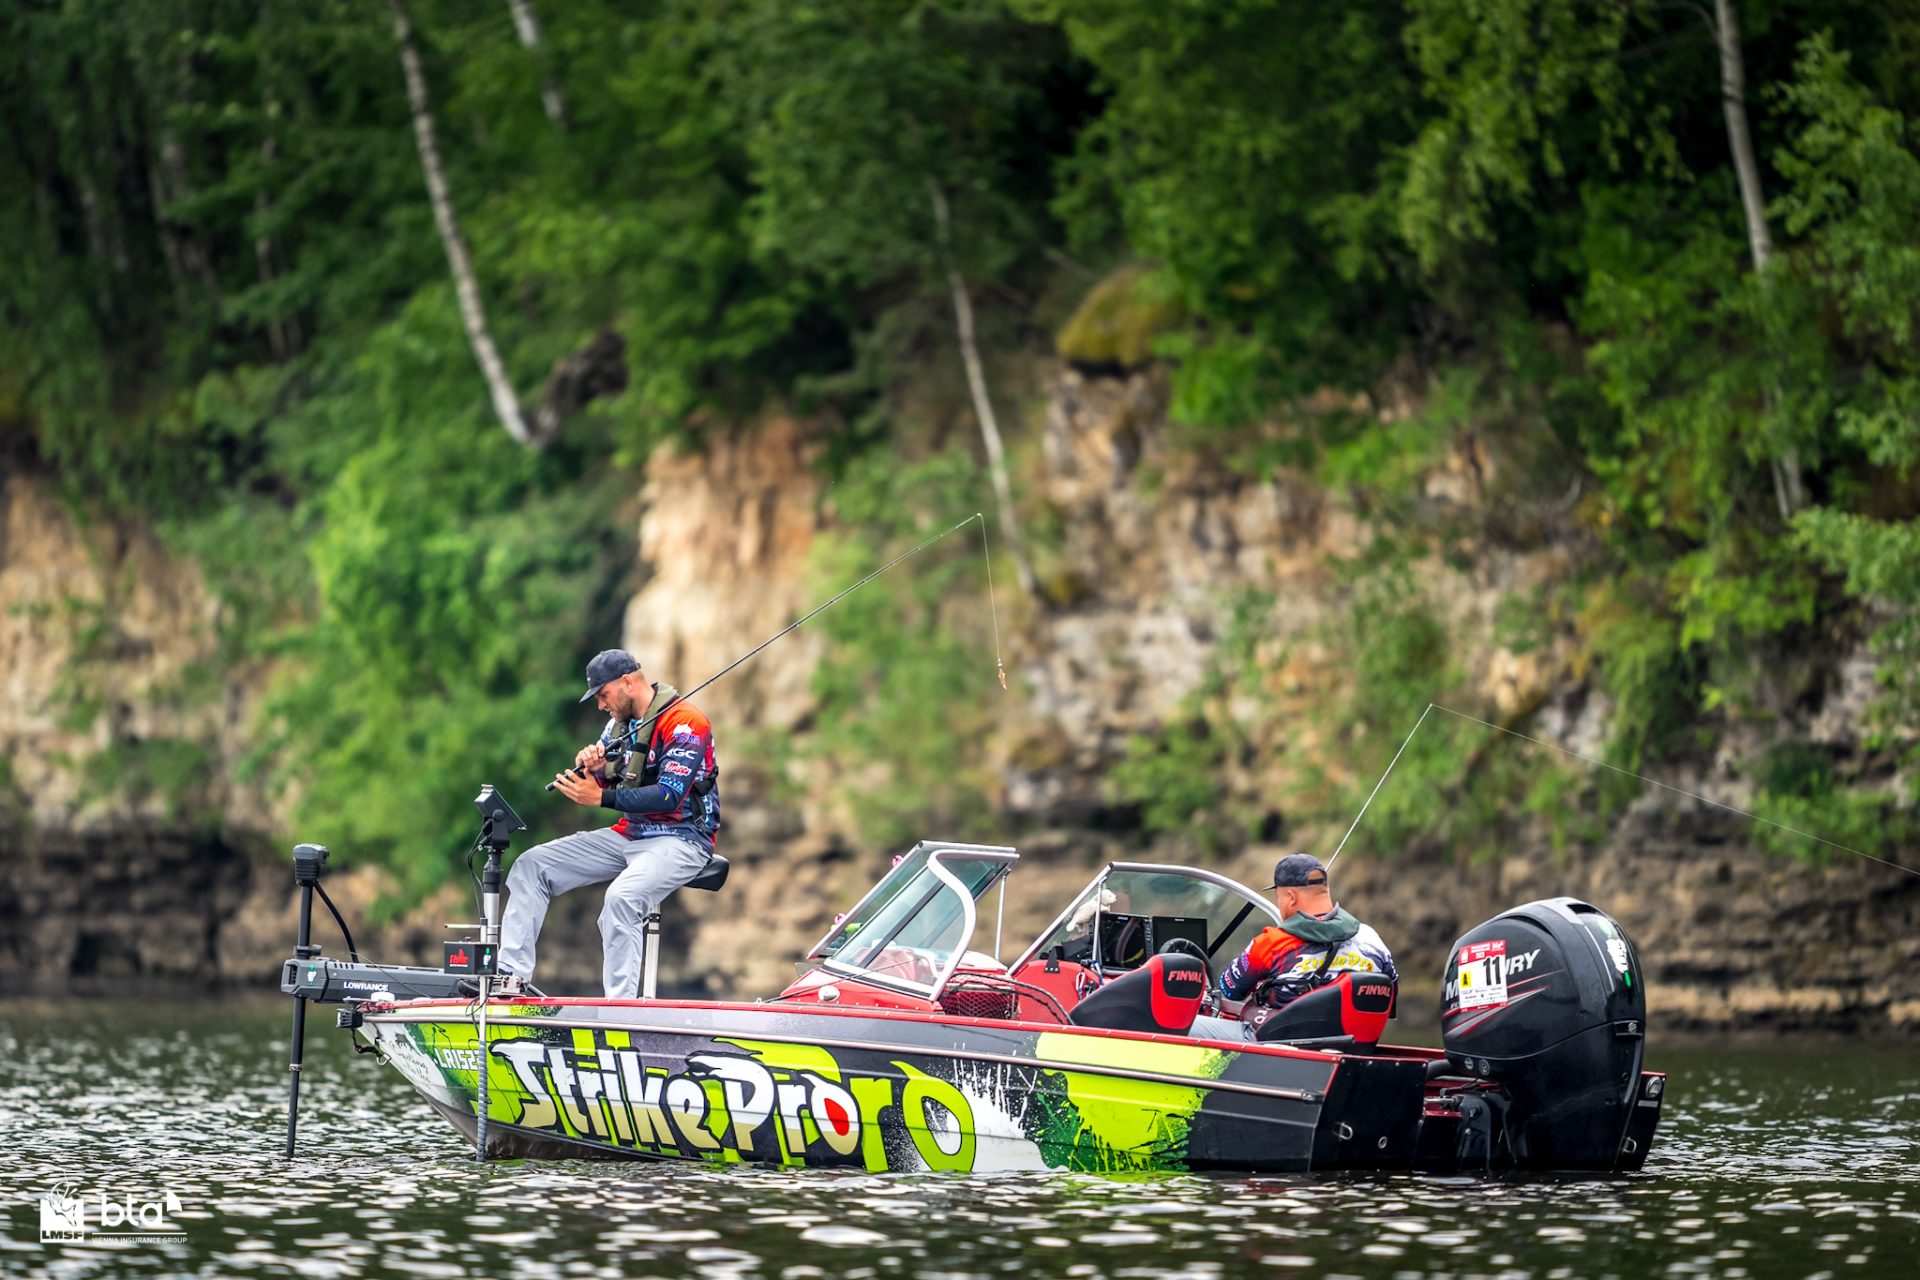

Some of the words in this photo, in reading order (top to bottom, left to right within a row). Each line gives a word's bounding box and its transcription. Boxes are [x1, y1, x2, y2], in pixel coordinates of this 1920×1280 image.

[1168, 970, 1202, 984] FINVAL
[1483, 956, 1501, 987] 11
[343, 981, 389, 992] LOWRANCE
[1357, 984, 1391, 998] FINVAL
